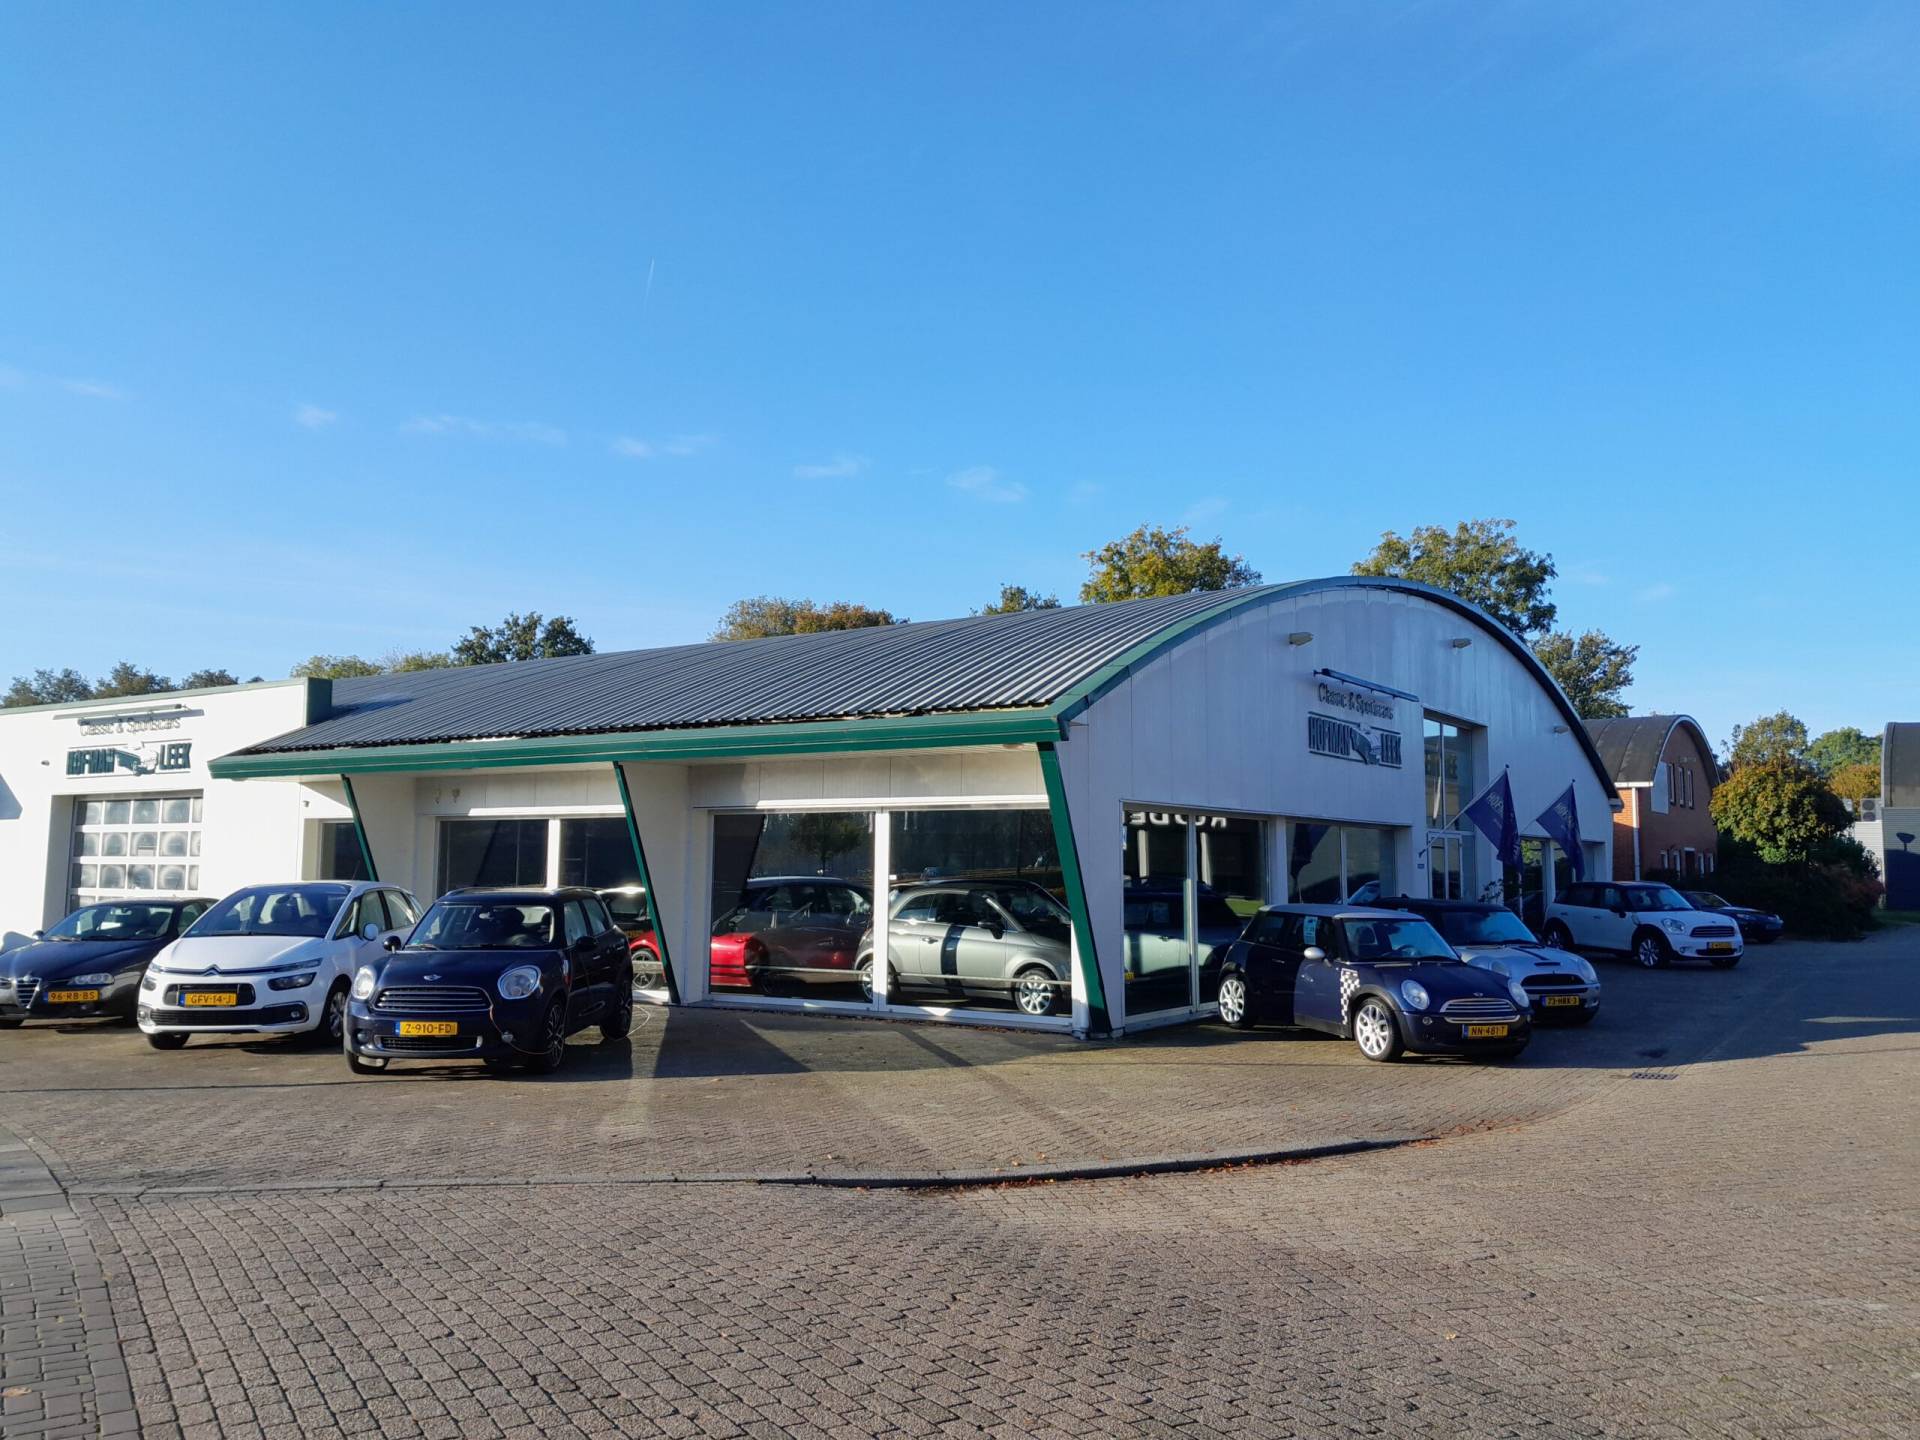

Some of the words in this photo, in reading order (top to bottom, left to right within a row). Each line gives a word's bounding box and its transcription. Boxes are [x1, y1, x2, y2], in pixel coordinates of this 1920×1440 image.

[1308, 716, 1351, 756] HOFMAN
[1380, 733, 1402, 765] LEEK
[159, 743, 192, 770] LEEK
[405, 1023, 452, 1034] Z-910-FD
